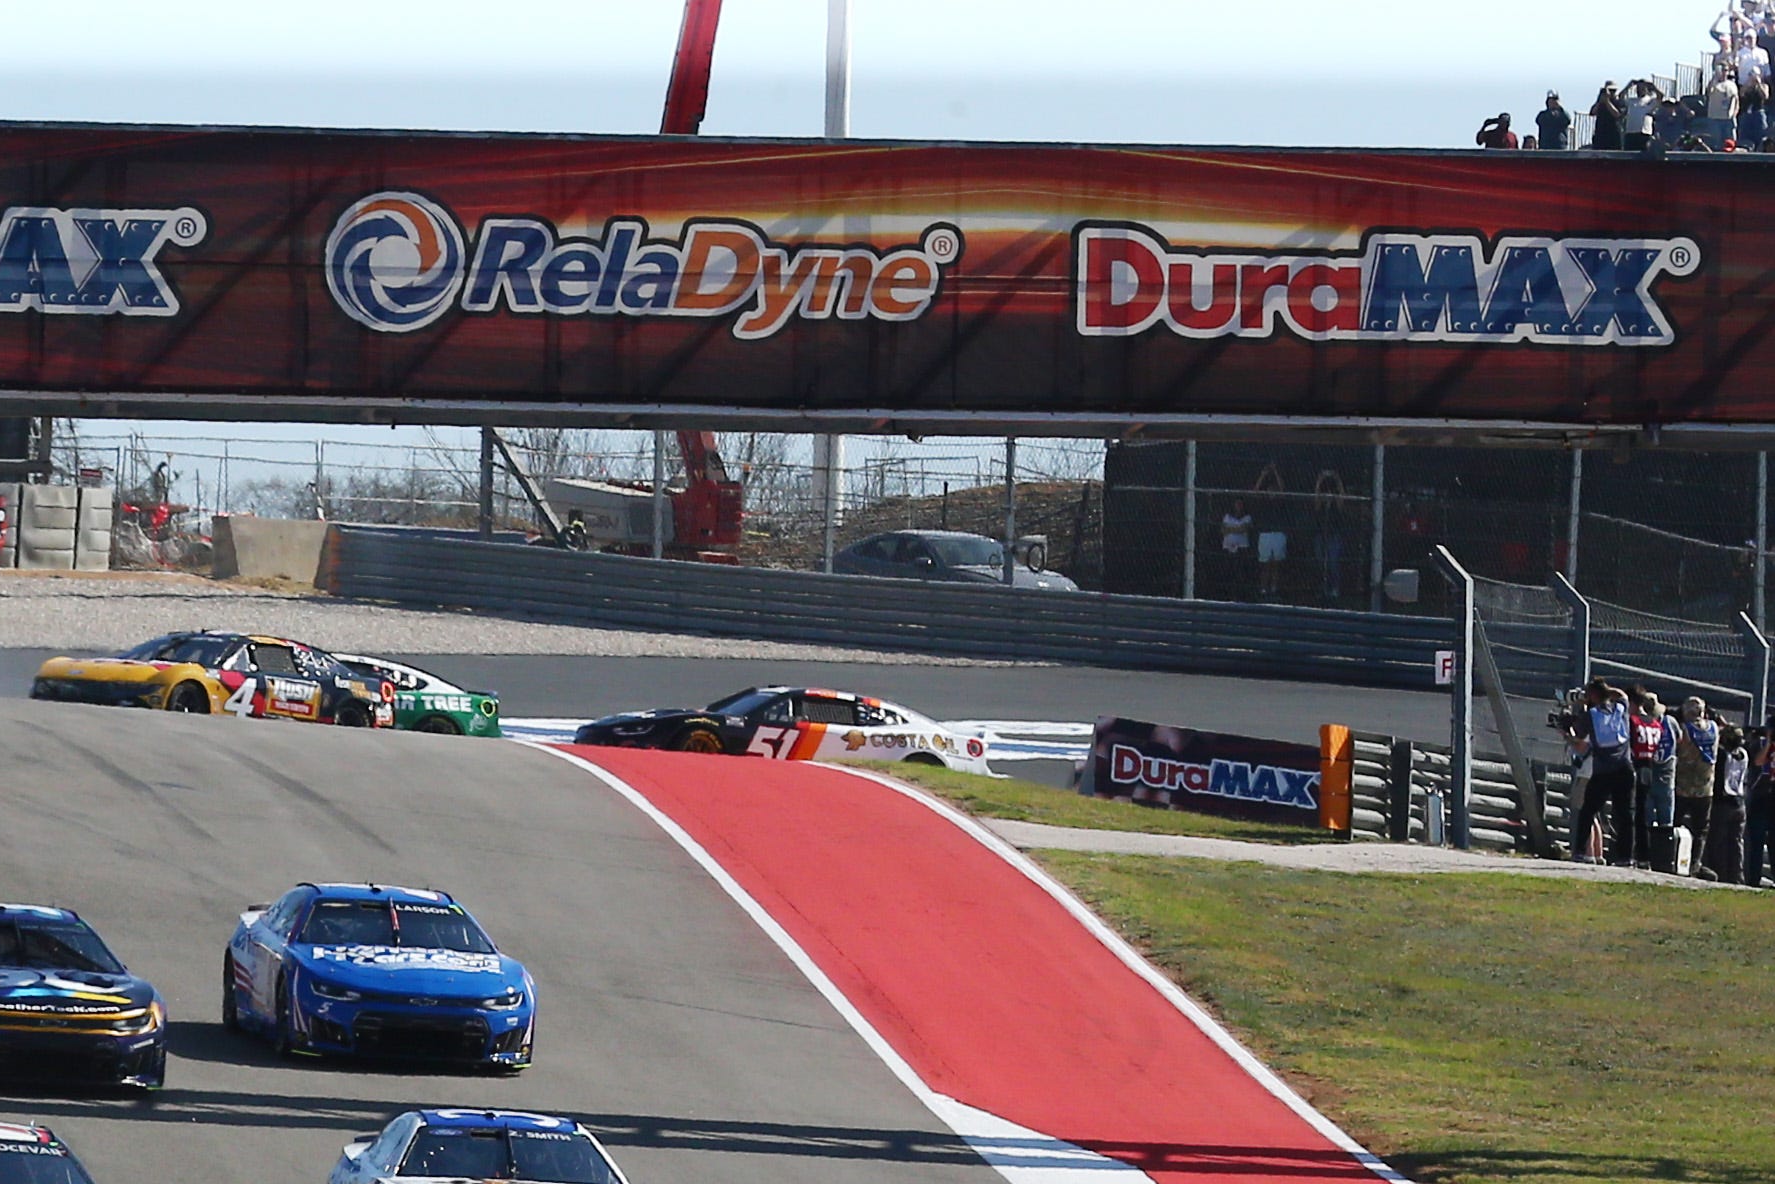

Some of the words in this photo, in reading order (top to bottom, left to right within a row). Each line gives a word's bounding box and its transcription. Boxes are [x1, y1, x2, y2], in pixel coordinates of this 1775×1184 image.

[224, 677, 258, 718] 4
[420, 695, 474, 713] TREE
[746, 725, 801, 760] 51
[870, 732, 932, 750] COSTA
[1111, 743, 1321, 811] DuraMAX
[395, 903, 450, 915] LARSON
[526, 1131, 572, 1142] SMITH
